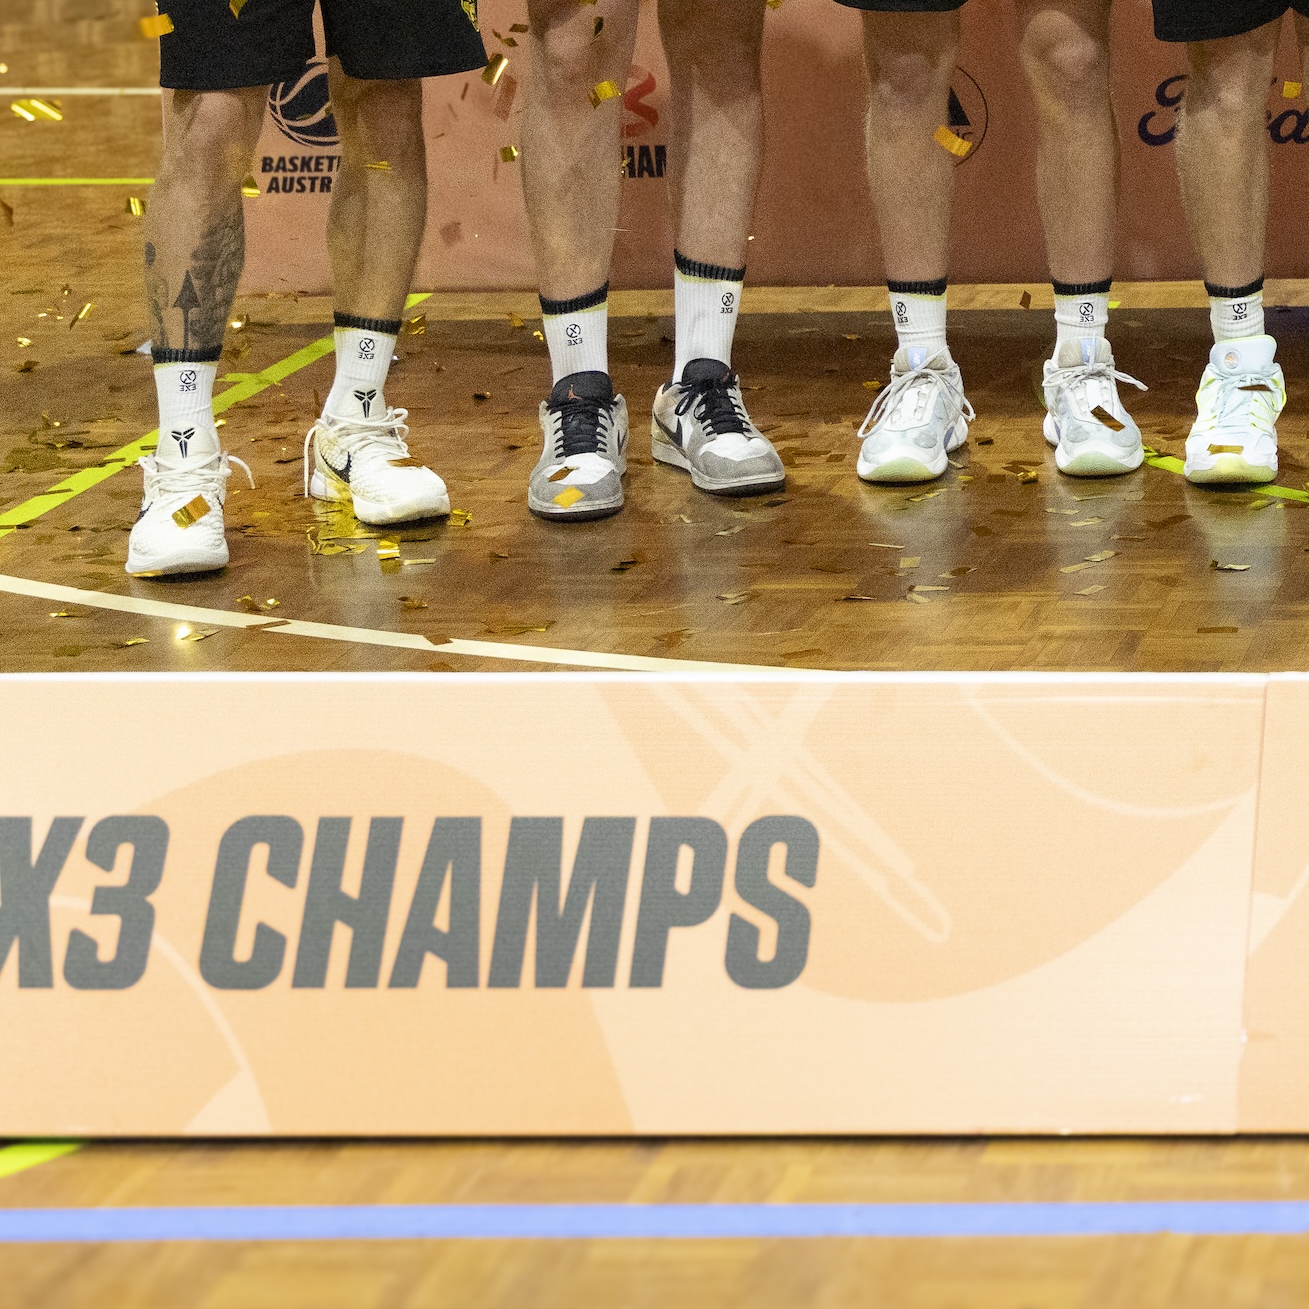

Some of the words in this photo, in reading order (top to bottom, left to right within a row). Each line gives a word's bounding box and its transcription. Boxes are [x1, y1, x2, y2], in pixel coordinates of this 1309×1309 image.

[266, 176, 333, 194] AUSTR
[0, 815, 171, 990] X3
[199, 814, 821, 990] CHAMPS
